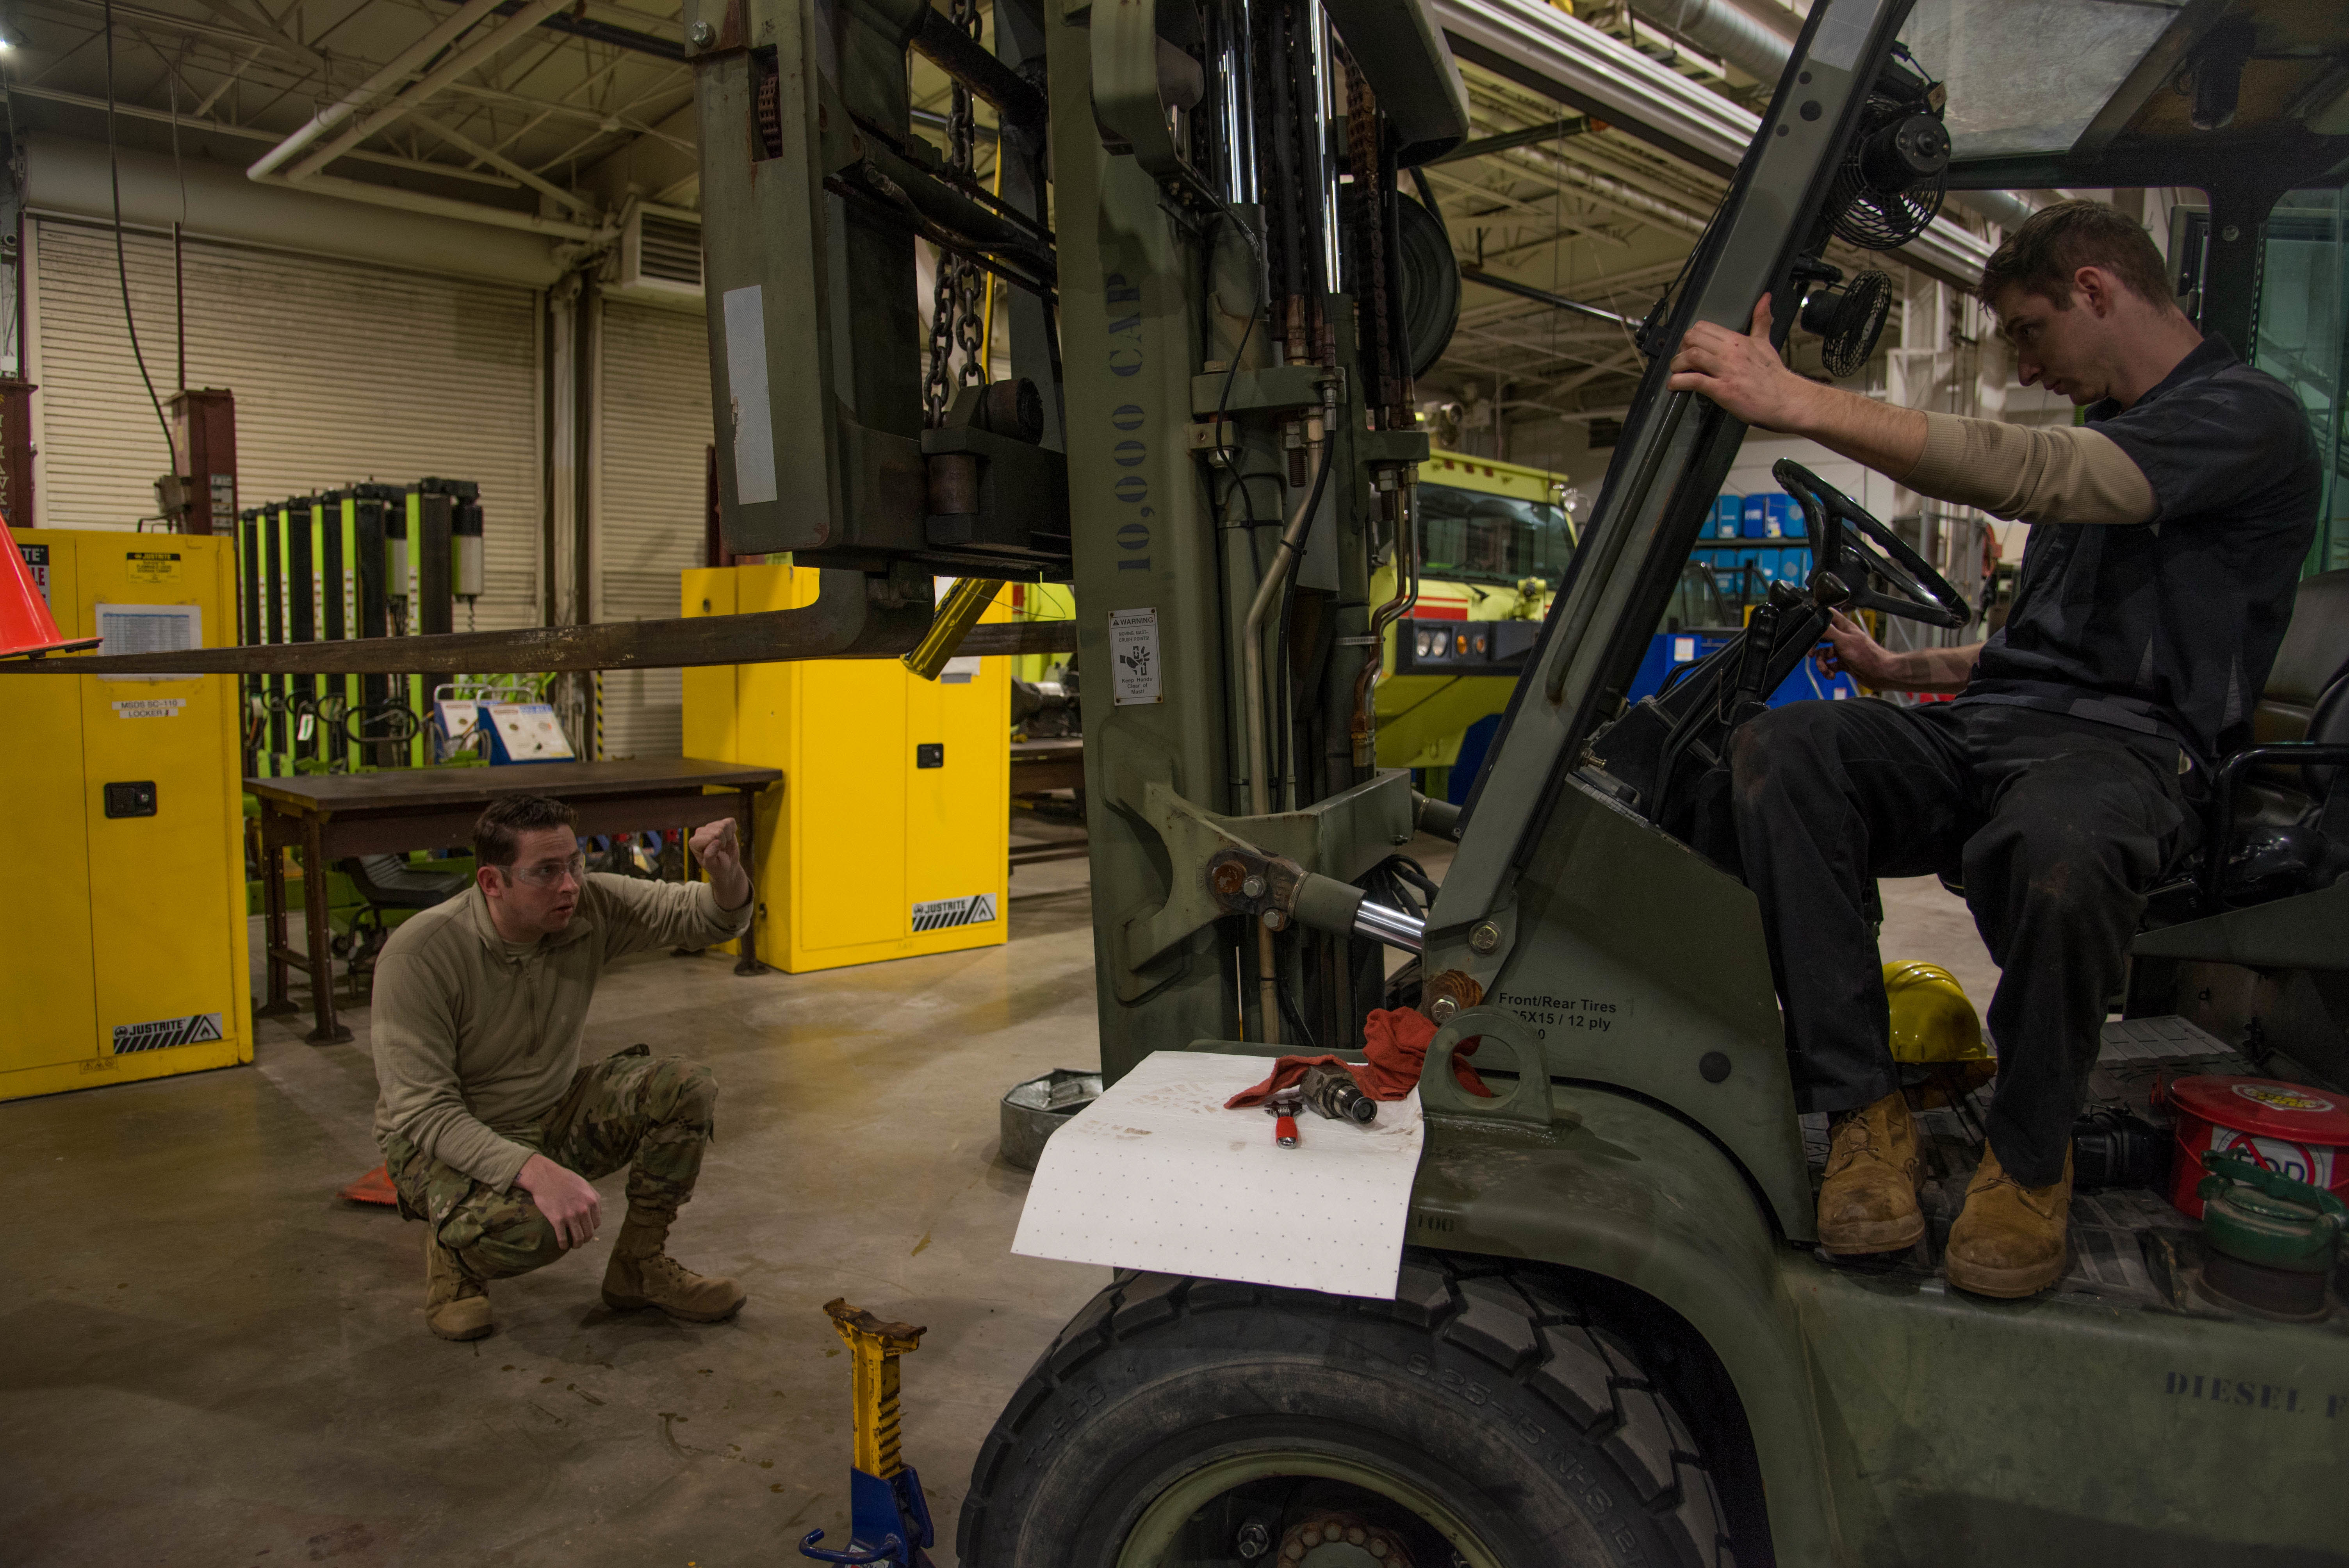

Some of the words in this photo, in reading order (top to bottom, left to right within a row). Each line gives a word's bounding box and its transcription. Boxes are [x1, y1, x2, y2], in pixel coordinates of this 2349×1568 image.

[1107, 274, 1142, 377] CAP
[1112, 404, 1154, 572] 10,000
[925, 899, 966, 914] JUSTRITE
[1499, 992, 1576, 1010] Front/Rear
[1581, 999, 1616, 1013] Tires
[129, 1019, 183, 1035] JUSTRITE
[1513, 1010, 1554, 1025] 5X15
[1568, 1015, 1584, 1027] 12
[1589, 1017, 1611, 1032] ply
[2166, 1371, 2304, 1413] DIESEL
[1547, 1446, 1613, 1514] NHS
